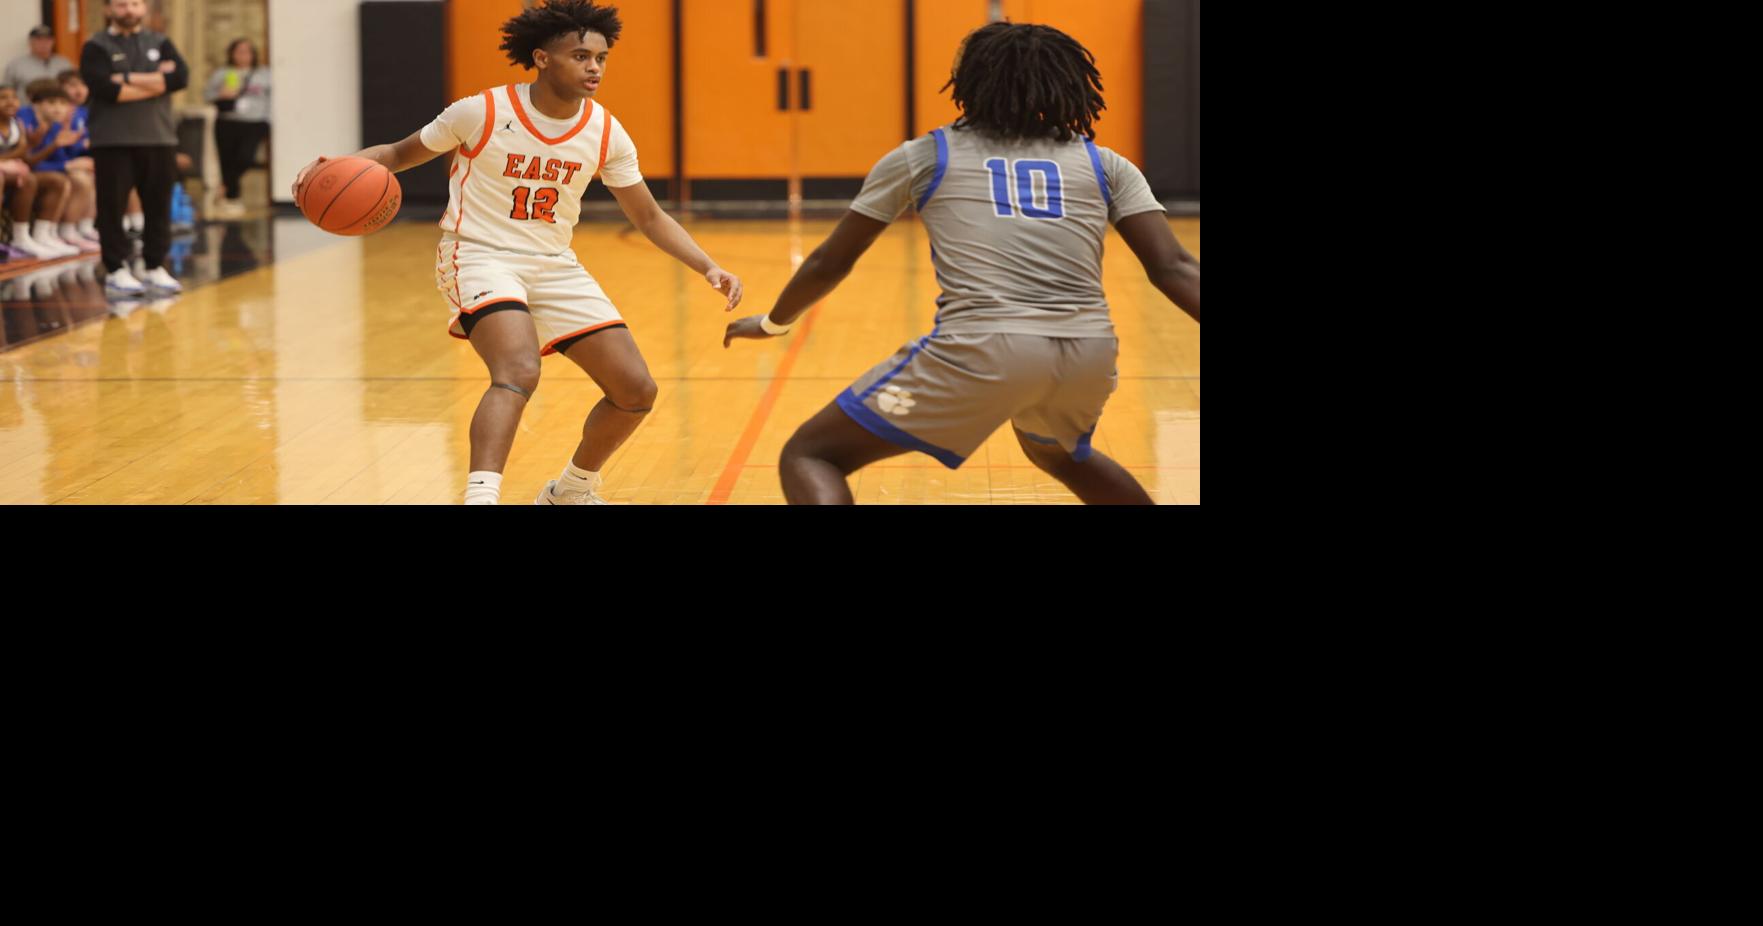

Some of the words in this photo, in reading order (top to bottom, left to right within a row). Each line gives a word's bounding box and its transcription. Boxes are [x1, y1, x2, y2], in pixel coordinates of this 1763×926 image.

[503, 153, 582, 185] EAST
[510, 186, 559, 223] 12
[983, 156, 1066, 220] 10
